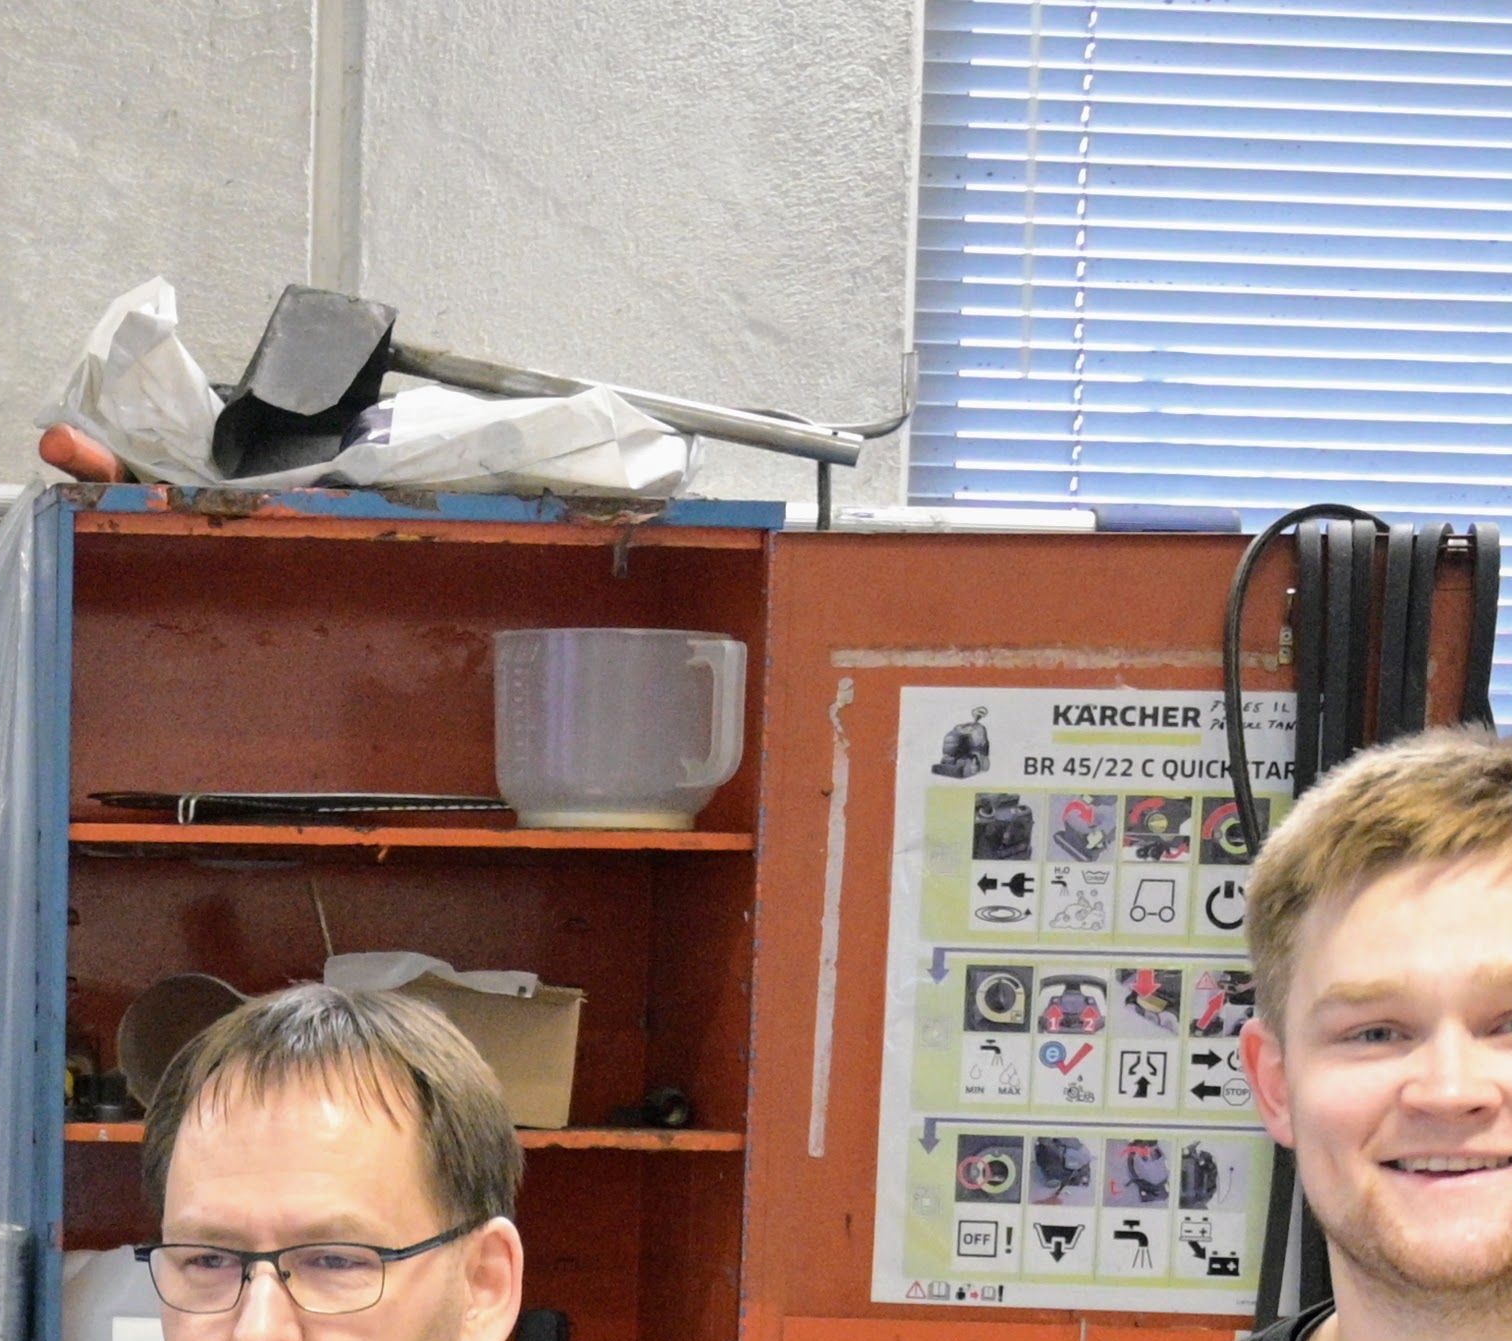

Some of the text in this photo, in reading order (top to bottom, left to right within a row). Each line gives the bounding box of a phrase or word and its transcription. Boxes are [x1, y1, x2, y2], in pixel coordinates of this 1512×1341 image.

[1052, 704, 1201, 728] KÄRCHER
[1268, 720, 1296, 731] TAN
[1023, 757, 1054, 775] BR
[1063, 757, 1133, 778] 45/22
[1141, 759, 1154, 776] C
[1049, 1018, 1057, 1030] 1
[1084, 1018, 1094, 1030] 2
[965, 1086, 985, 1095] MIN
[998, 1086, 1020, 1096] MAX
[1224, 1088, 1248, 1097] STOP
[964, 1230, 992, 1248] OFF
